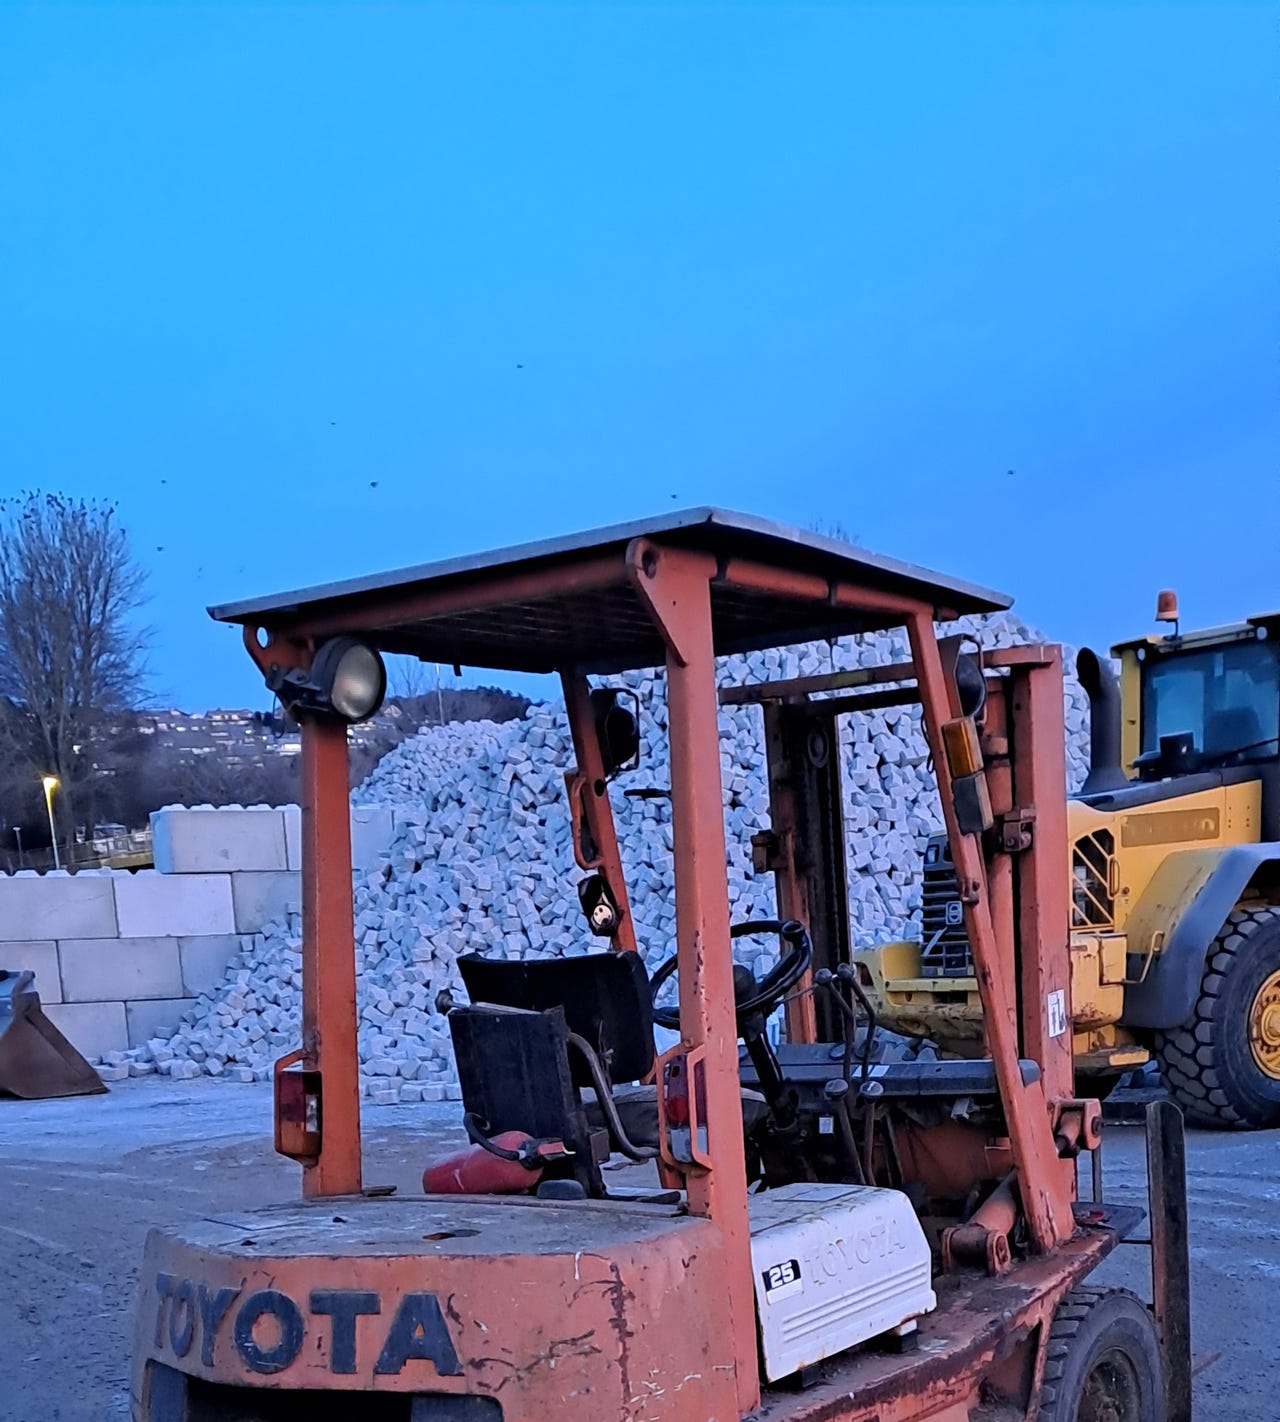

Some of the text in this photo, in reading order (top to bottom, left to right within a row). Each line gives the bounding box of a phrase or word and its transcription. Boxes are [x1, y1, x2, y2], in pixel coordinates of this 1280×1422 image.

[769, 1262, 795, 1288] 25
[803, 1218, 907, 1286] TOYOTA
[156, 1272, 465, 1376] TOYOTA
